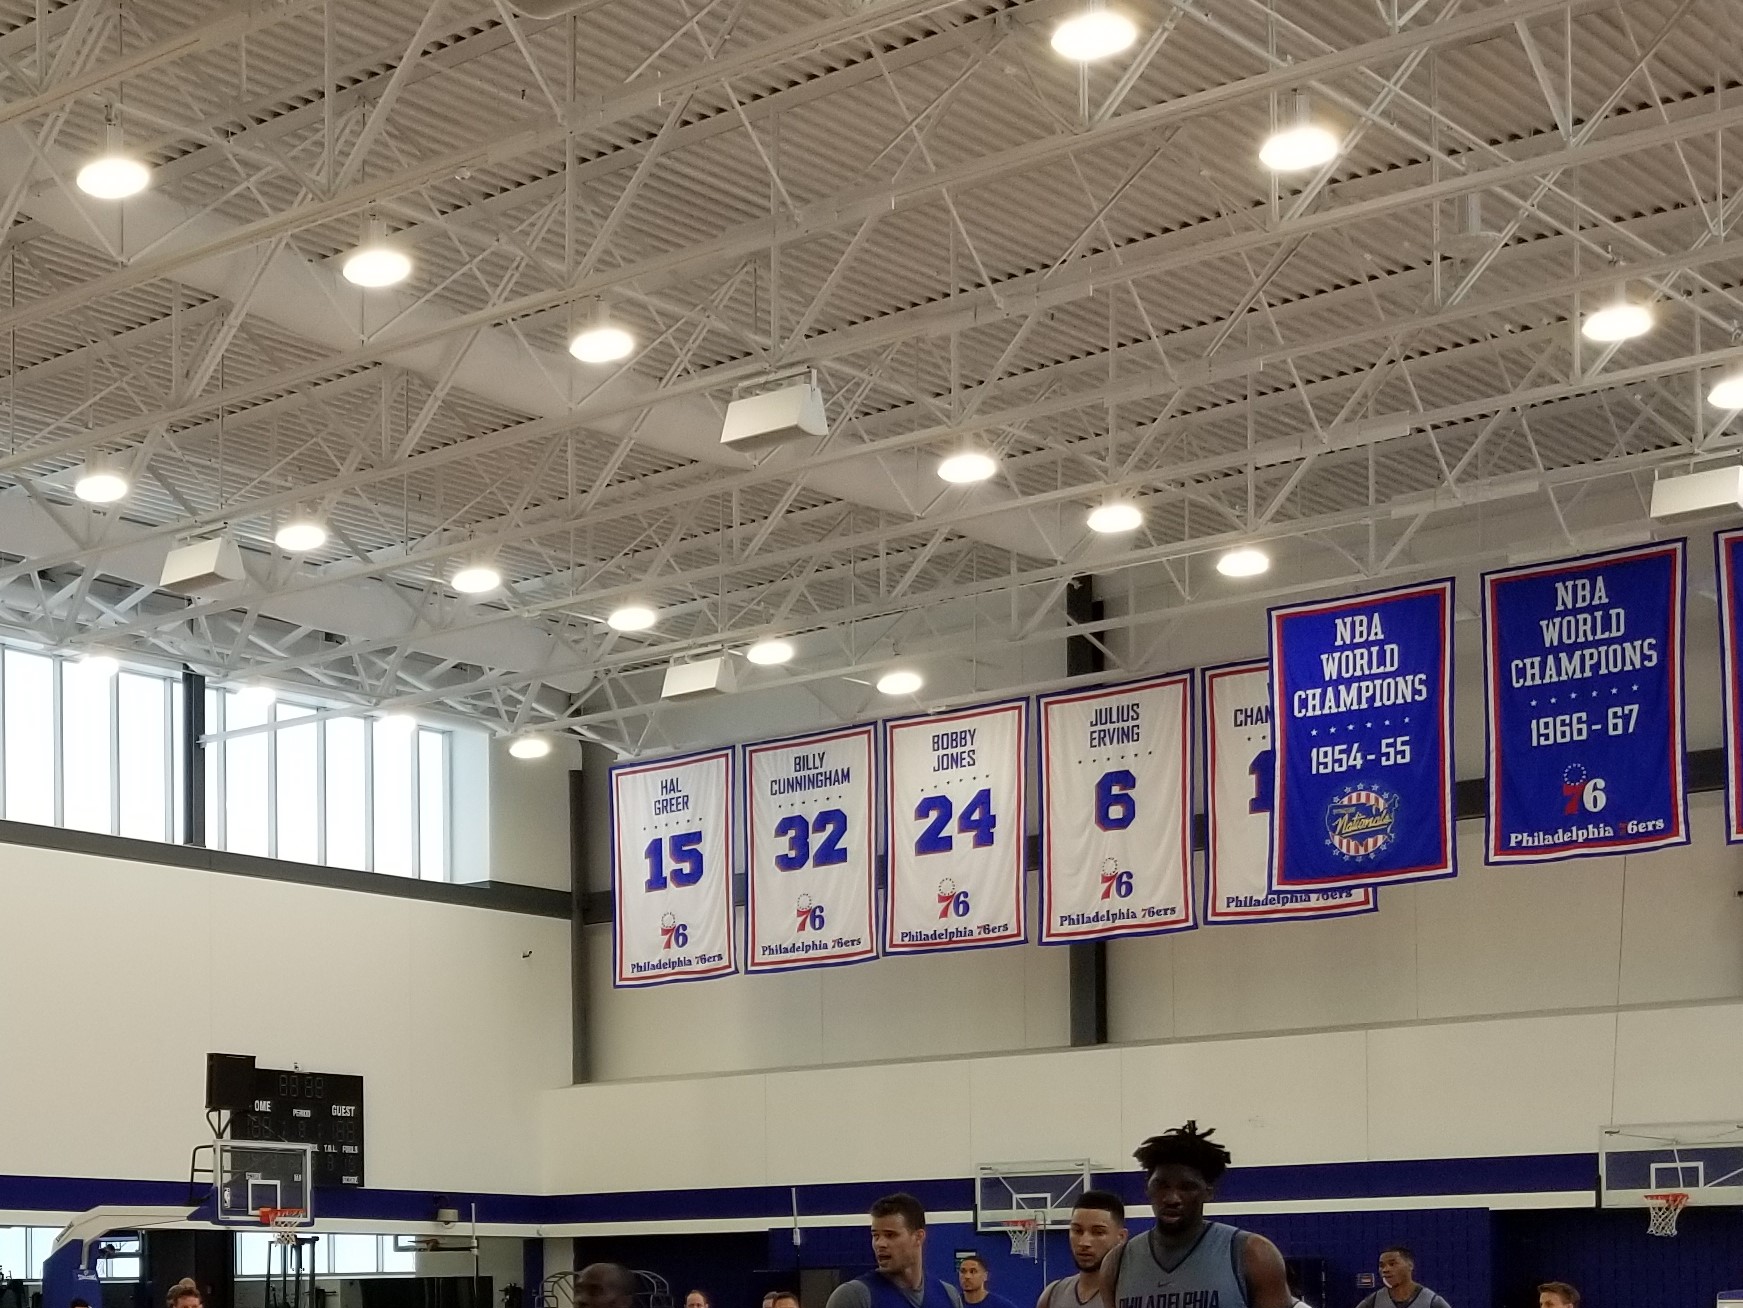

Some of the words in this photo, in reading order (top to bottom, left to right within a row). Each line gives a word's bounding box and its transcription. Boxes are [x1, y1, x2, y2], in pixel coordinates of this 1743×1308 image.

[1555, 575, 1609, 611] NBA
[1334, 612, 1385, 647] NBA
[1539, 608, 1625, 648] WORLD
[1320, 643, 1399, 682] WORLD
[1511, 638, 1658, 688] CHAMPIONS
[1293, 673, 1428, 719] CHAMPIONS
[1090, 703, 1140, 727] JULIUS
[932, 728, 977, 752] BOBBY
[1089, 724, 1140, 749] ERVING
[793, 751, 826, 773] BILLY
[933, 749, 976, 772] JONES
[660, 777, 682, 796] HAL
[770, 767, 851, 796] CUNNINGHAM
[654, 795, 689, 816] GREER
[1094, 769, 1136, 833] 6
[1563, 778, 1606, 815] 76
[914, 788, 997, 857] 24
[1332, 809, 1393, 835] Nationals
[1509, 823, 1614, 847] Philadelphia
[1619, 817, 1665, 836] 76ers
[774, 808, 848, 873] 32
[644, 830, 704, 893] 15
[1101, 870, 1134, 901] 76
[937, 890, 970, 920] 76
[1226, 891, 1311, 909] Philadelphia
[796, 905, 825, 933] 76
[1059, 910, 1138, 927] Philadelphia
[1141, 906, 1177, 919] 76ers
[660, 923, 689, 950] 76
[761, 941, 828, 956] Philadelphia
[832, 937, 862, 950] 76ers
[900, 927, 974, 943] Philadelphia
[976, 923, 1009, 936] 76ers
[631, 956, 692, 974] Philadelphia
[695, 953, 723, 965] 76ers
[254, 1100, 271, 1113] OME
[331, 1105, 356, 1117] GUEST
